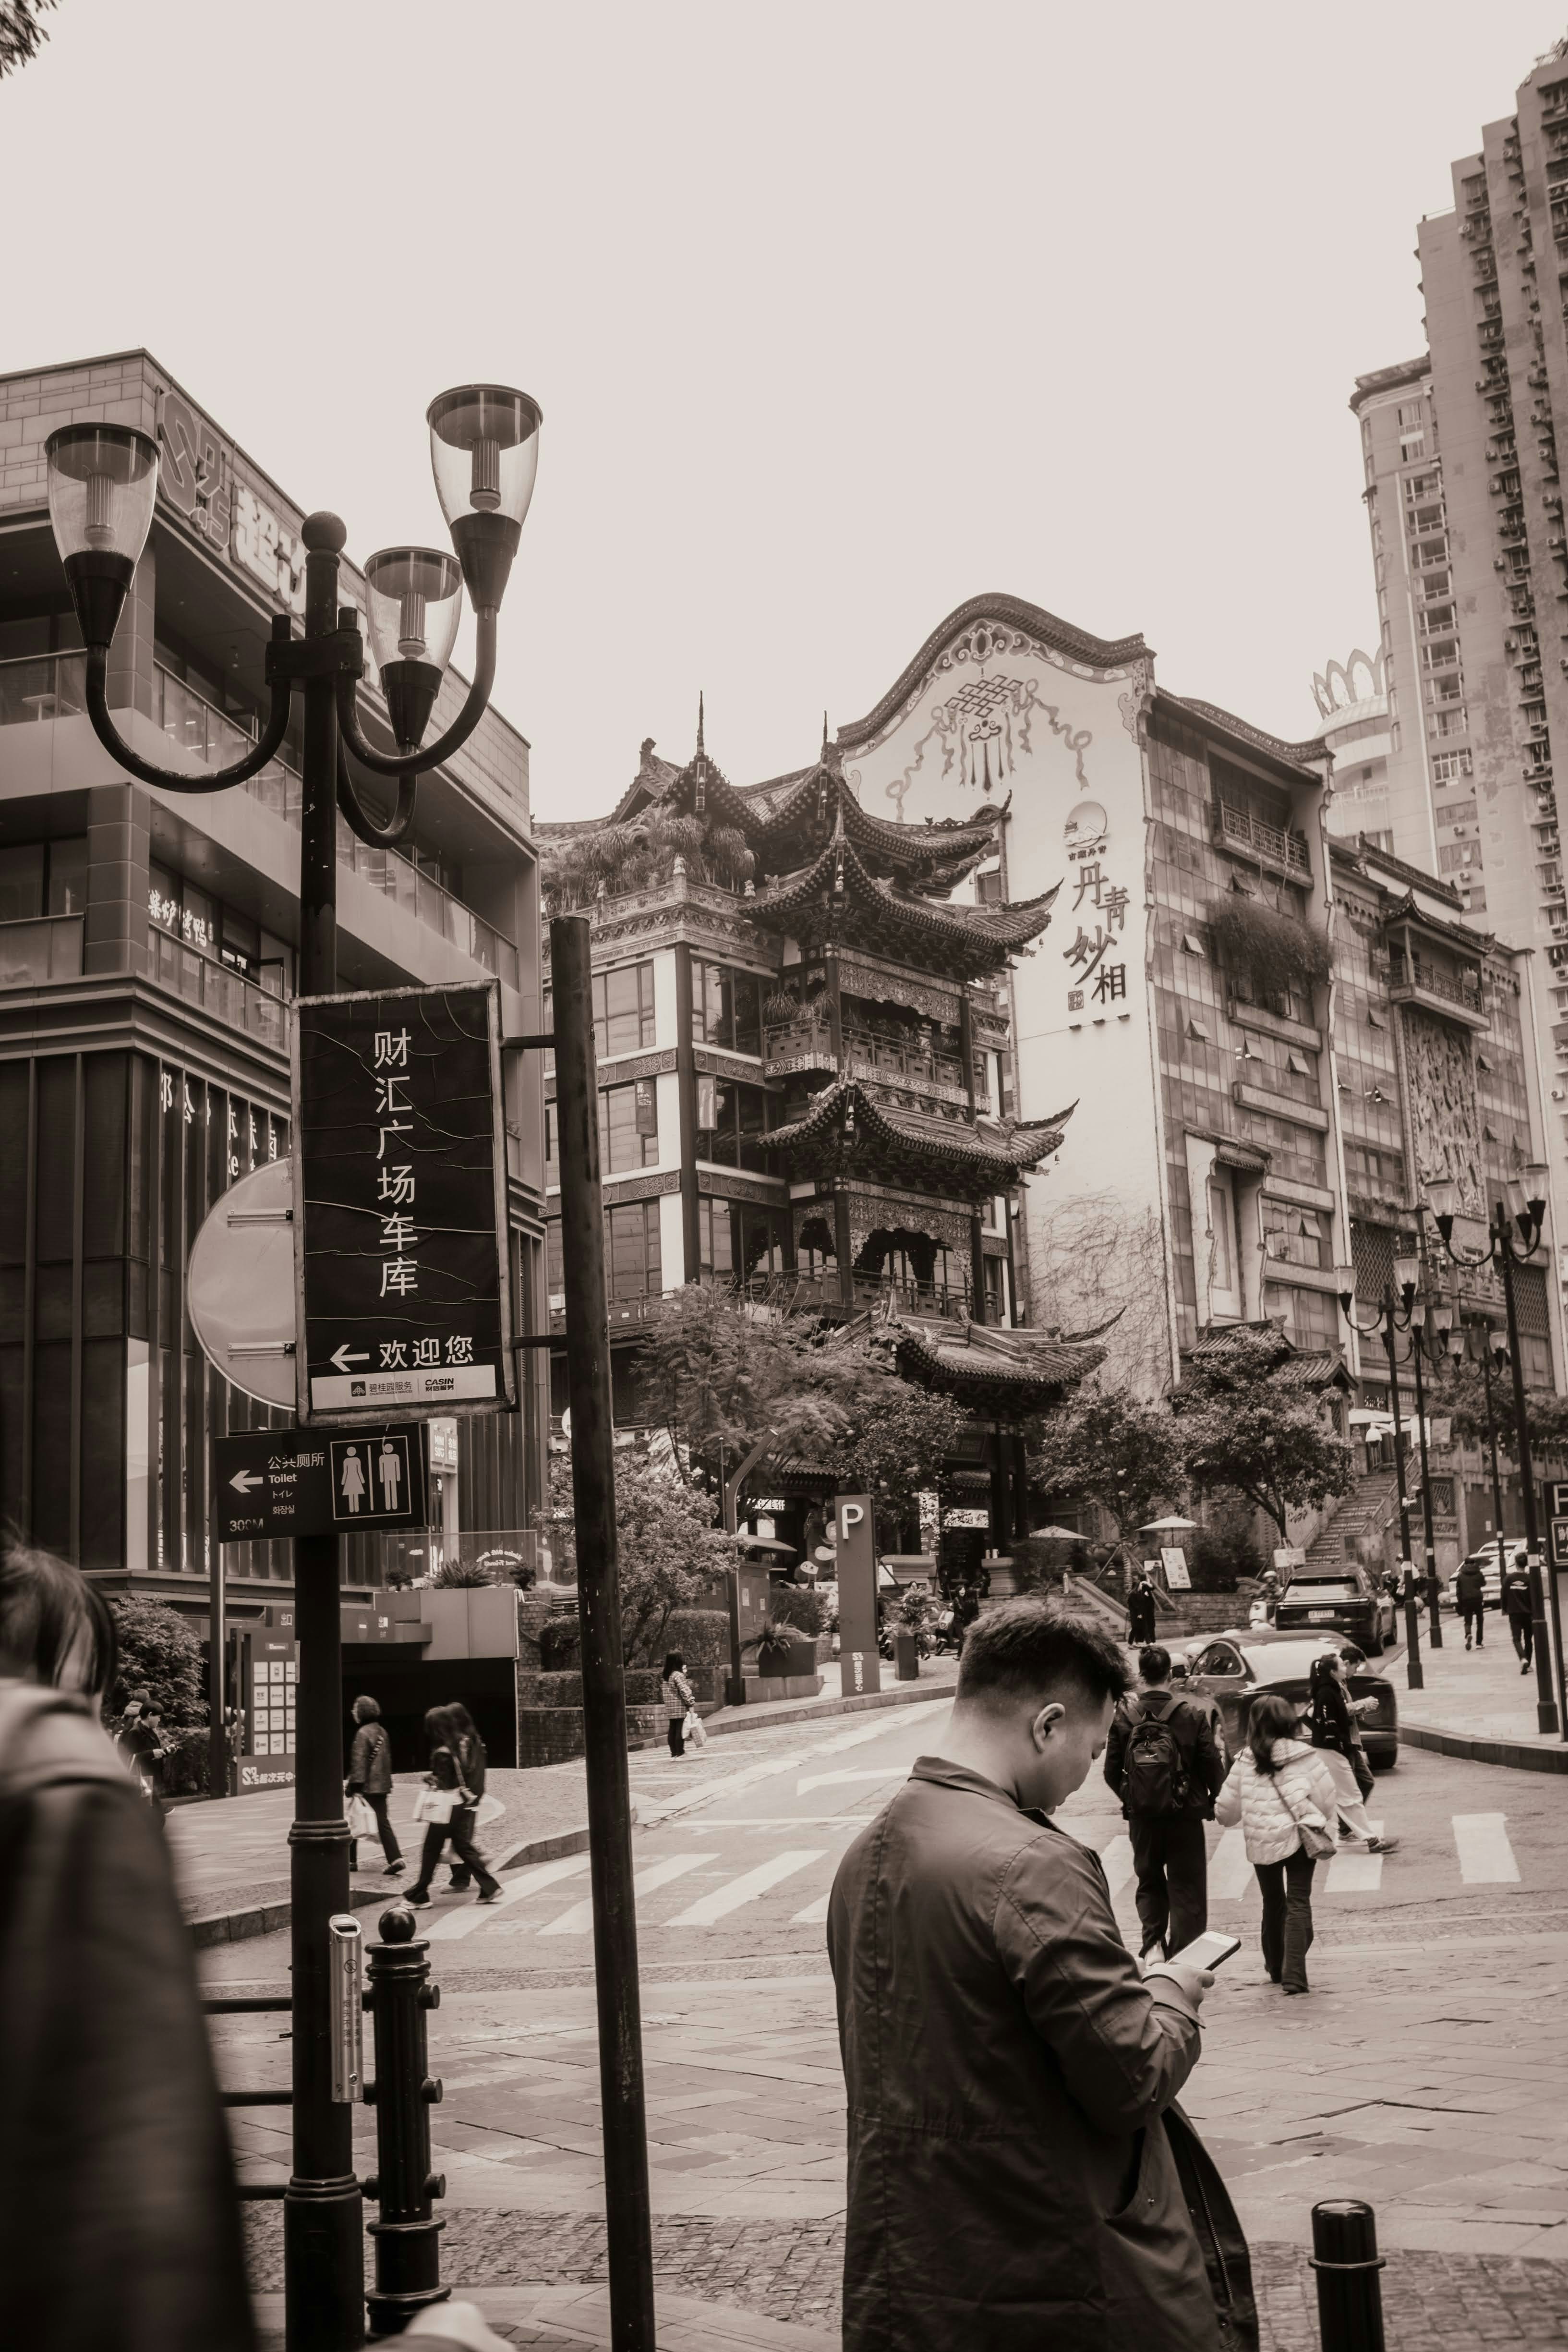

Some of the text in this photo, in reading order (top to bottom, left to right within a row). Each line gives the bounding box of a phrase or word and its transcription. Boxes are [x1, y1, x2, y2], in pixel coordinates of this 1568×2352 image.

[374, 1028, 419, 1298] 财汇广场车库
[379, 1335, 474, 1370] 欢迎您
[369, 1382, 412, 1393] 碧桂园服务
[267, 1453, 326, 1470] 公共厕所
[268, 1473, 298, 1484] Toilet
[273, 1490, 293, 1499] トイレ
[273, 1504, 295, 1515] 화장실
[841, 1503, 864, 1540] P
[281, 1613, 292, 1626] 出口
